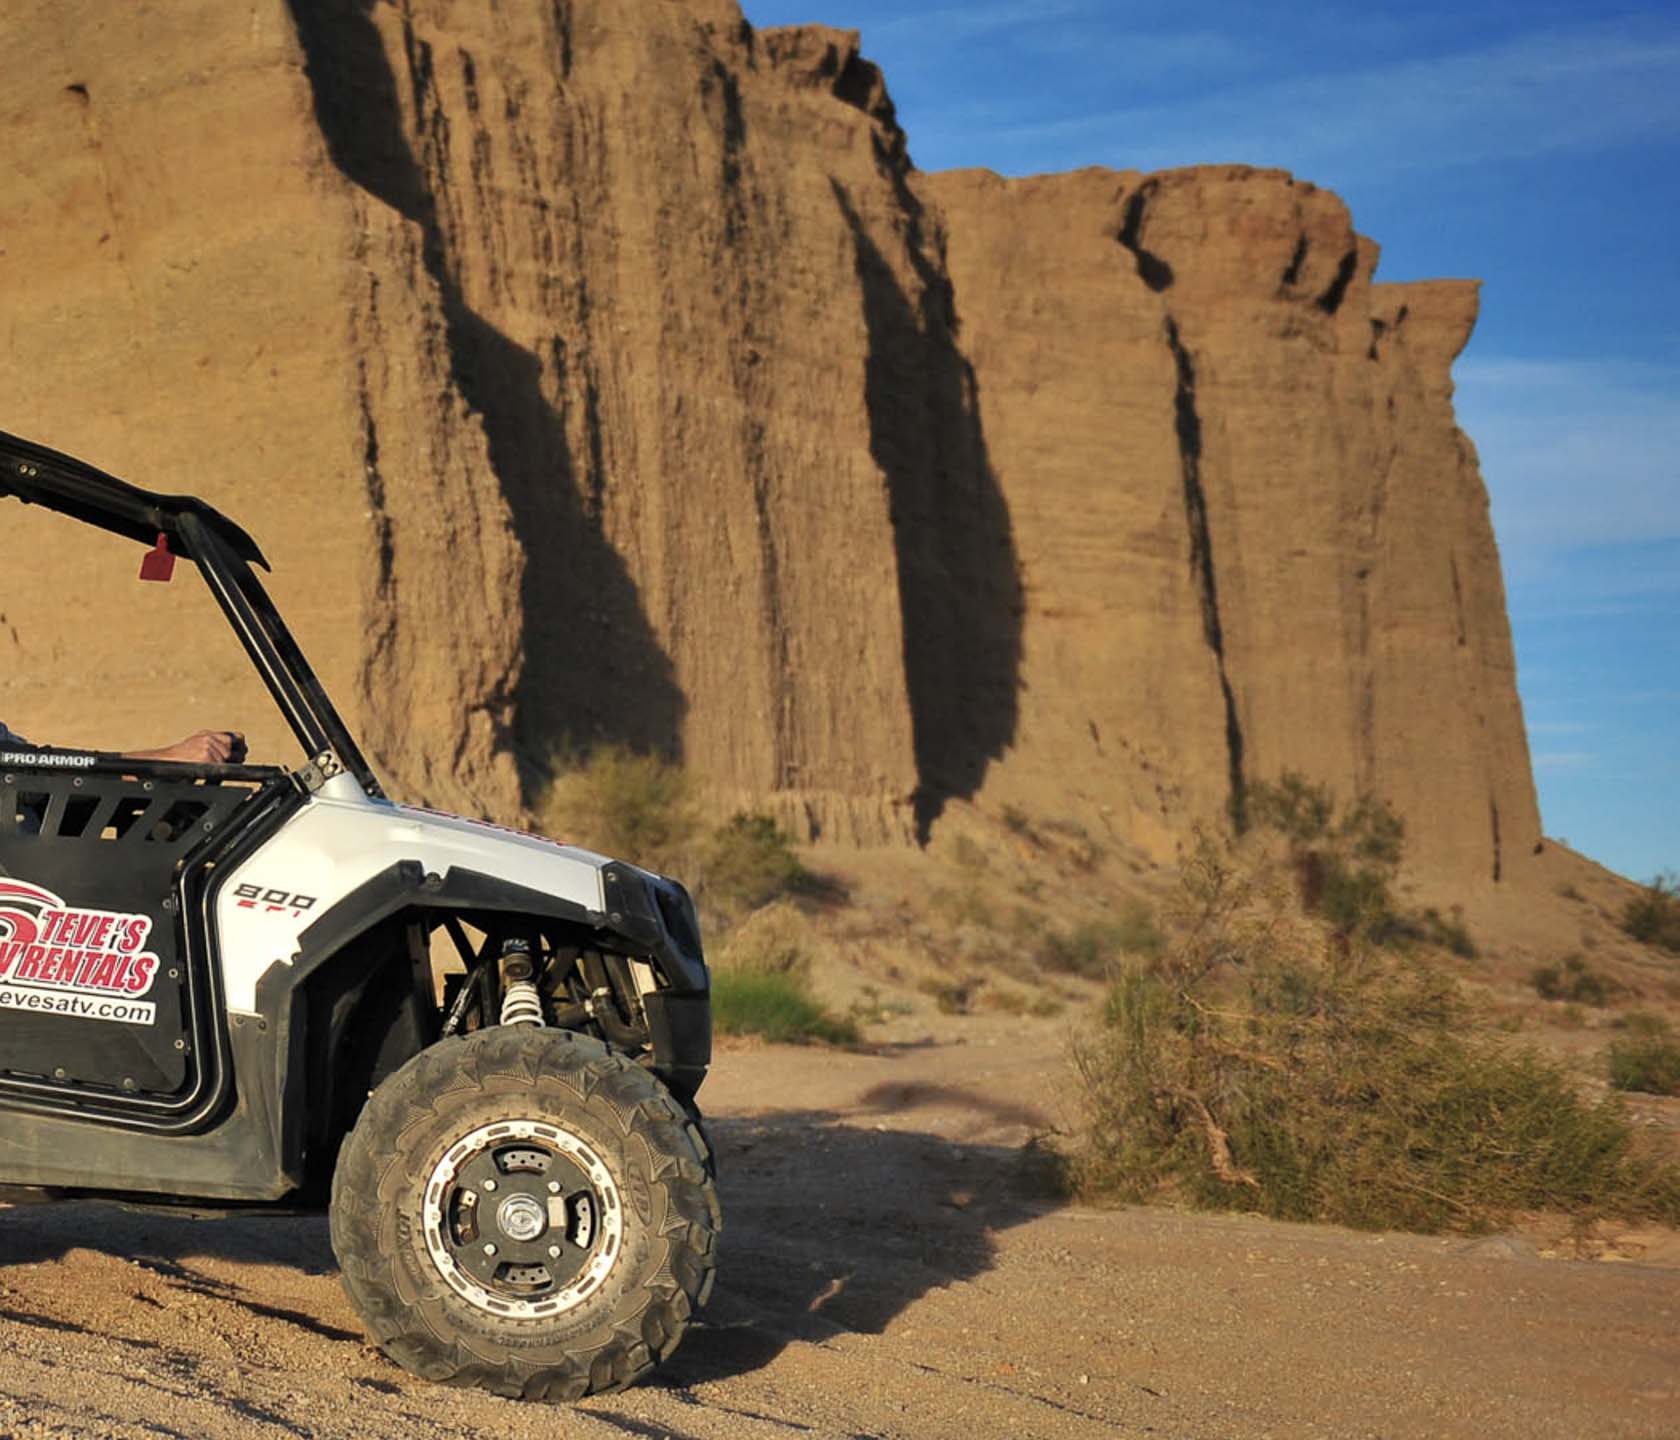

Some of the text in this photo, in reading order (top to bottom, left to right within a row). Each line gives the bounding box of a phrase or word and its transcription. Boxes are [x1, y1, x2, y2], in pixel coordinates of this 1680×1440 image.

[3, 752, 96, 767] PRO ARMOR
[233, 883, 317, 910] 800
[20, 945, 155, 992] RENTALS
